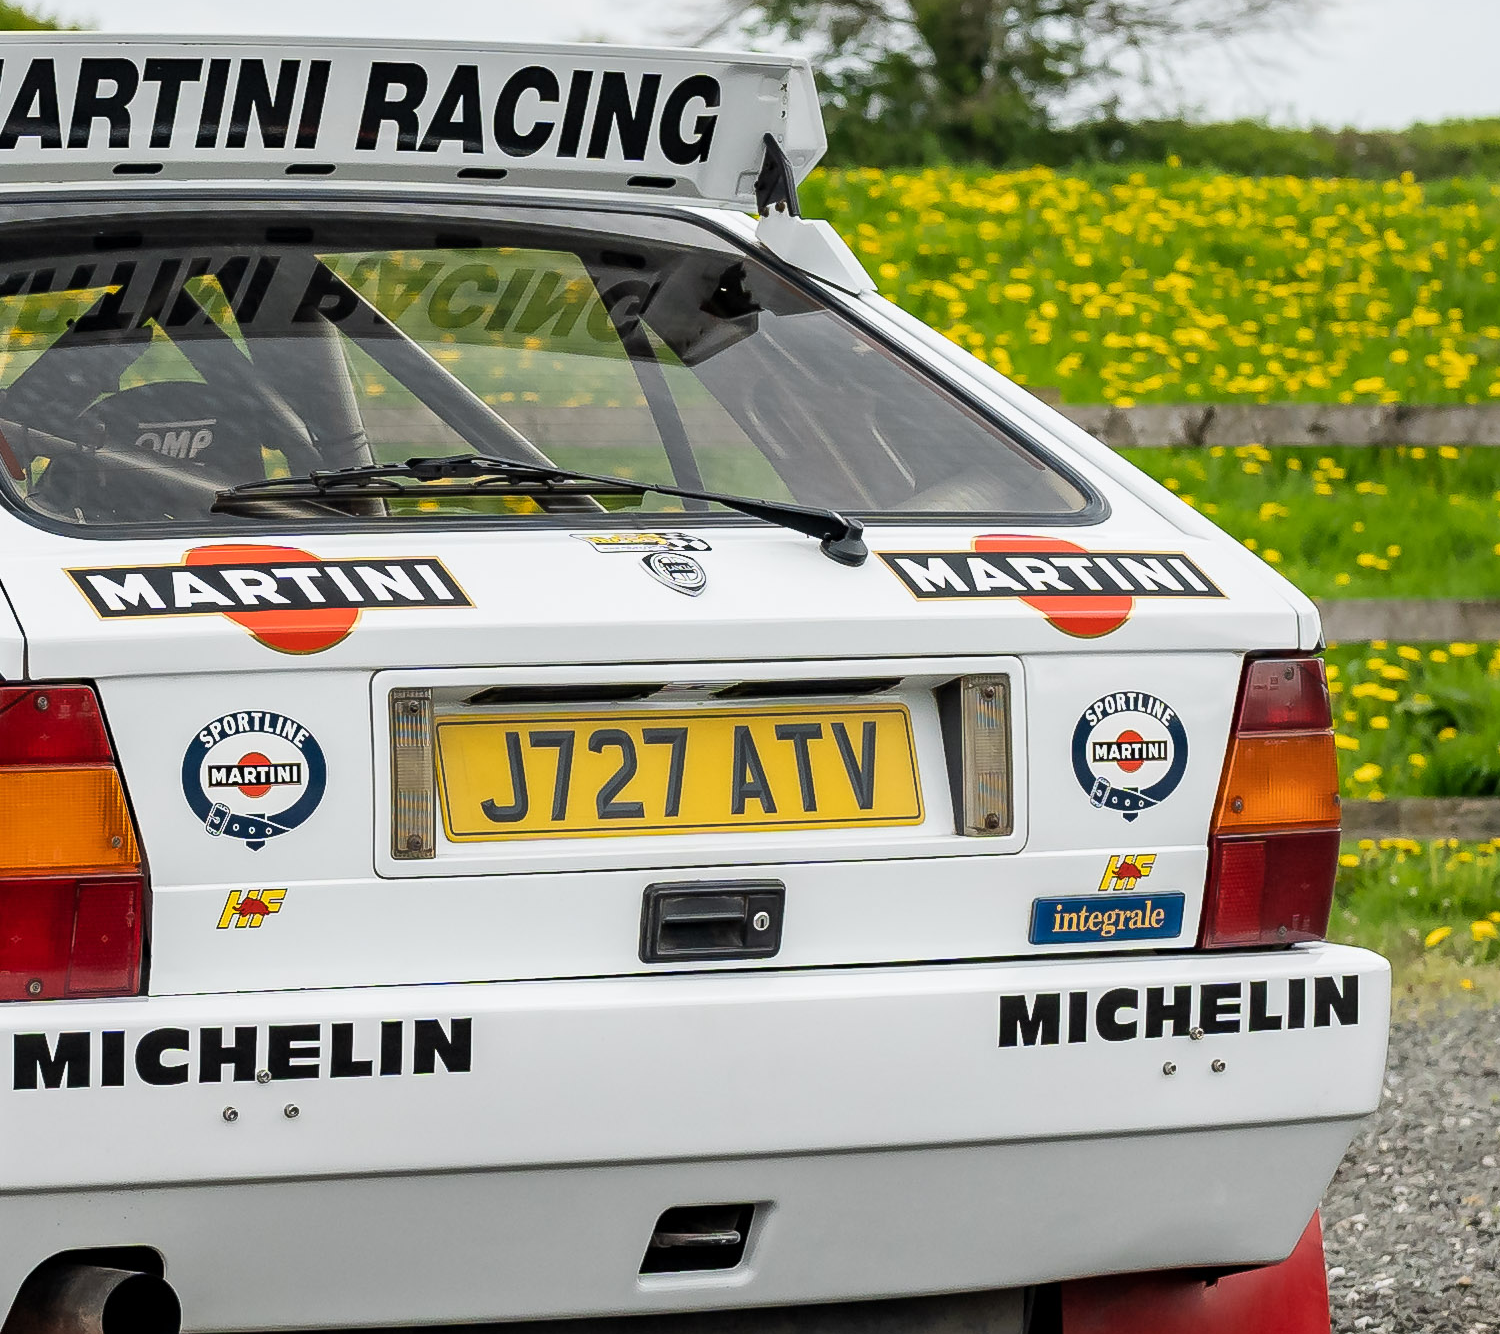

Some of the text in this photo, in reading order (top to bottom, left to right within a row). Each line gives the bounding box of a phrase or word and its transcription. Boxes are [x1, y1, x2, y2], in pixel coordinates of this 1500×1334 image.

[356, 62, 721, 165] RACING
[135, 429, 214, 459] OMP
[85, 563, 456, 613] MARTINI
[894, 556, 1209, 592] MARTINI
[1085, 693, 1174, 726] SPORTLINE
[199, 711, 309, 748] SPORTLINE
[1095, 742, 1166, 761] MARTINI
[210, 765, 298, 786] MARTINI
[480, 721, 877, 823] J727 ATV
[1052, 903, 1164, 938] integrale
[998, 975, 1359, 1048] MICHELIN
[12, 1017, 473, 1090] MICHELIN
